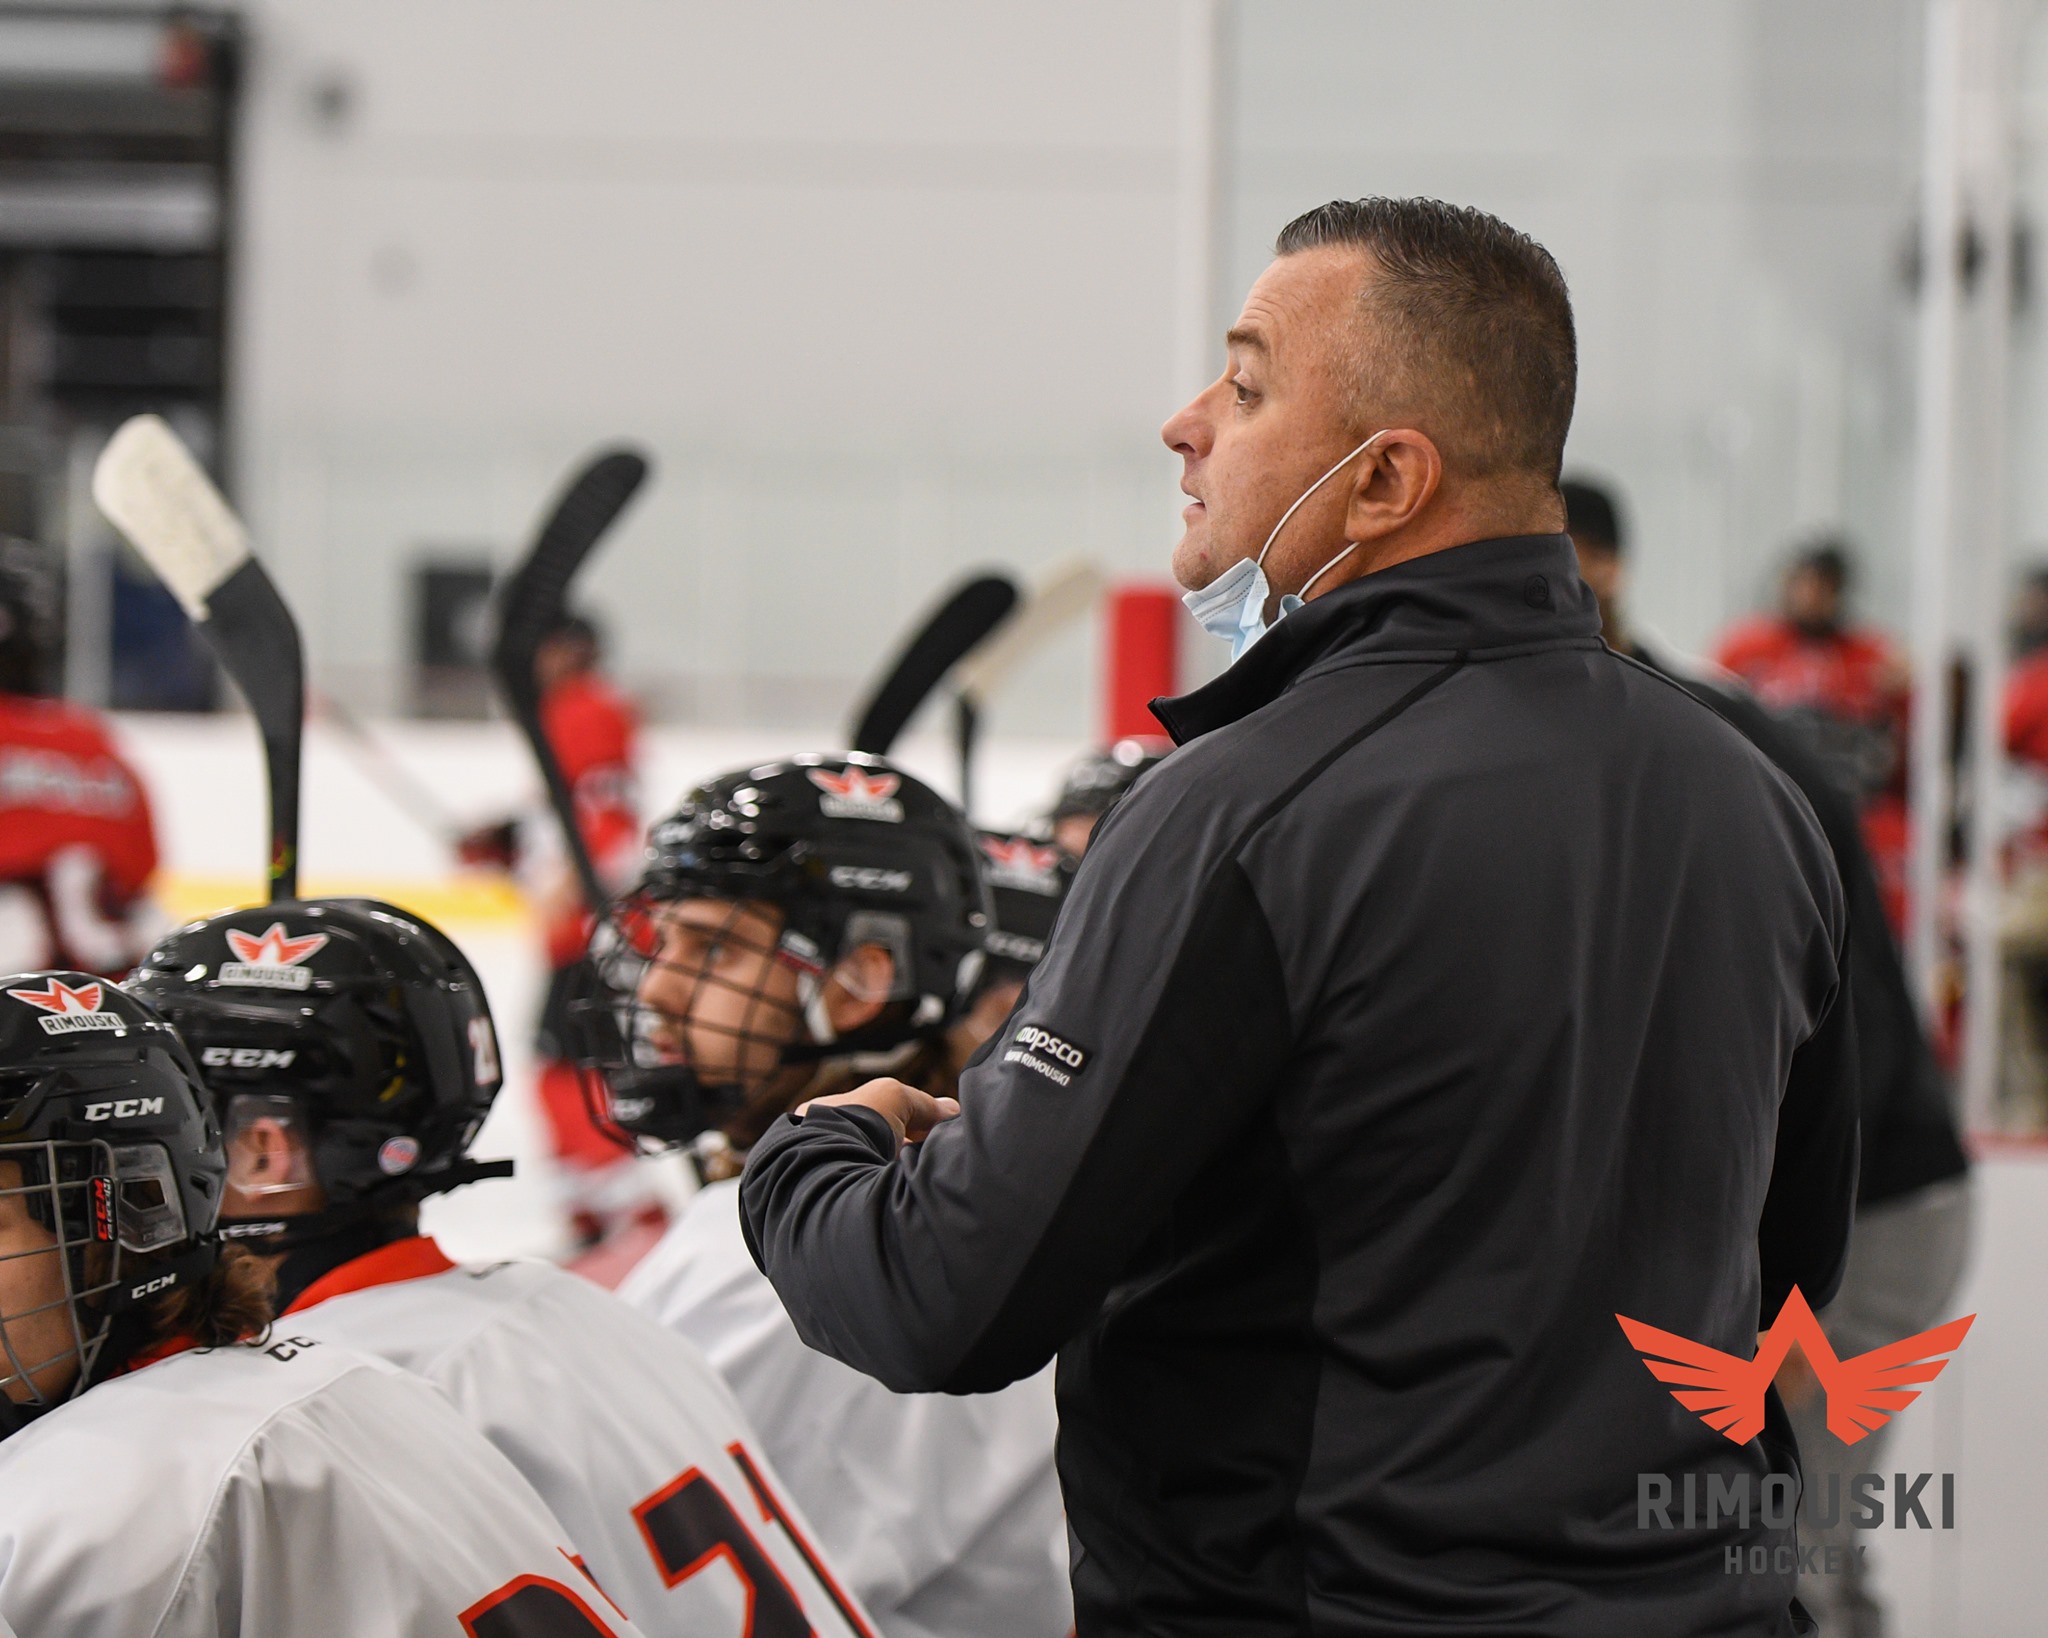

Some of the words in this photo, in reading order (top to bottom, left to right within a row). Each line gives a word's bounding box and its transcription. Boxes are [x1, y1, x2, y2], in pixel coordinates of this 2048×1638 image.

[43, 1015, 125, 1032] RIMOUSKI
[201, 1047, 297, 1069] CCM
[1021, 1053, 1071, 1087] RIMOUSKI
[84, 1097, 165, 1121] CCM
[93, 1178, 109, 1241] CCM
[131, 1273, 177, 1300] CCM
[263, 1336, 323, 1362] CC
